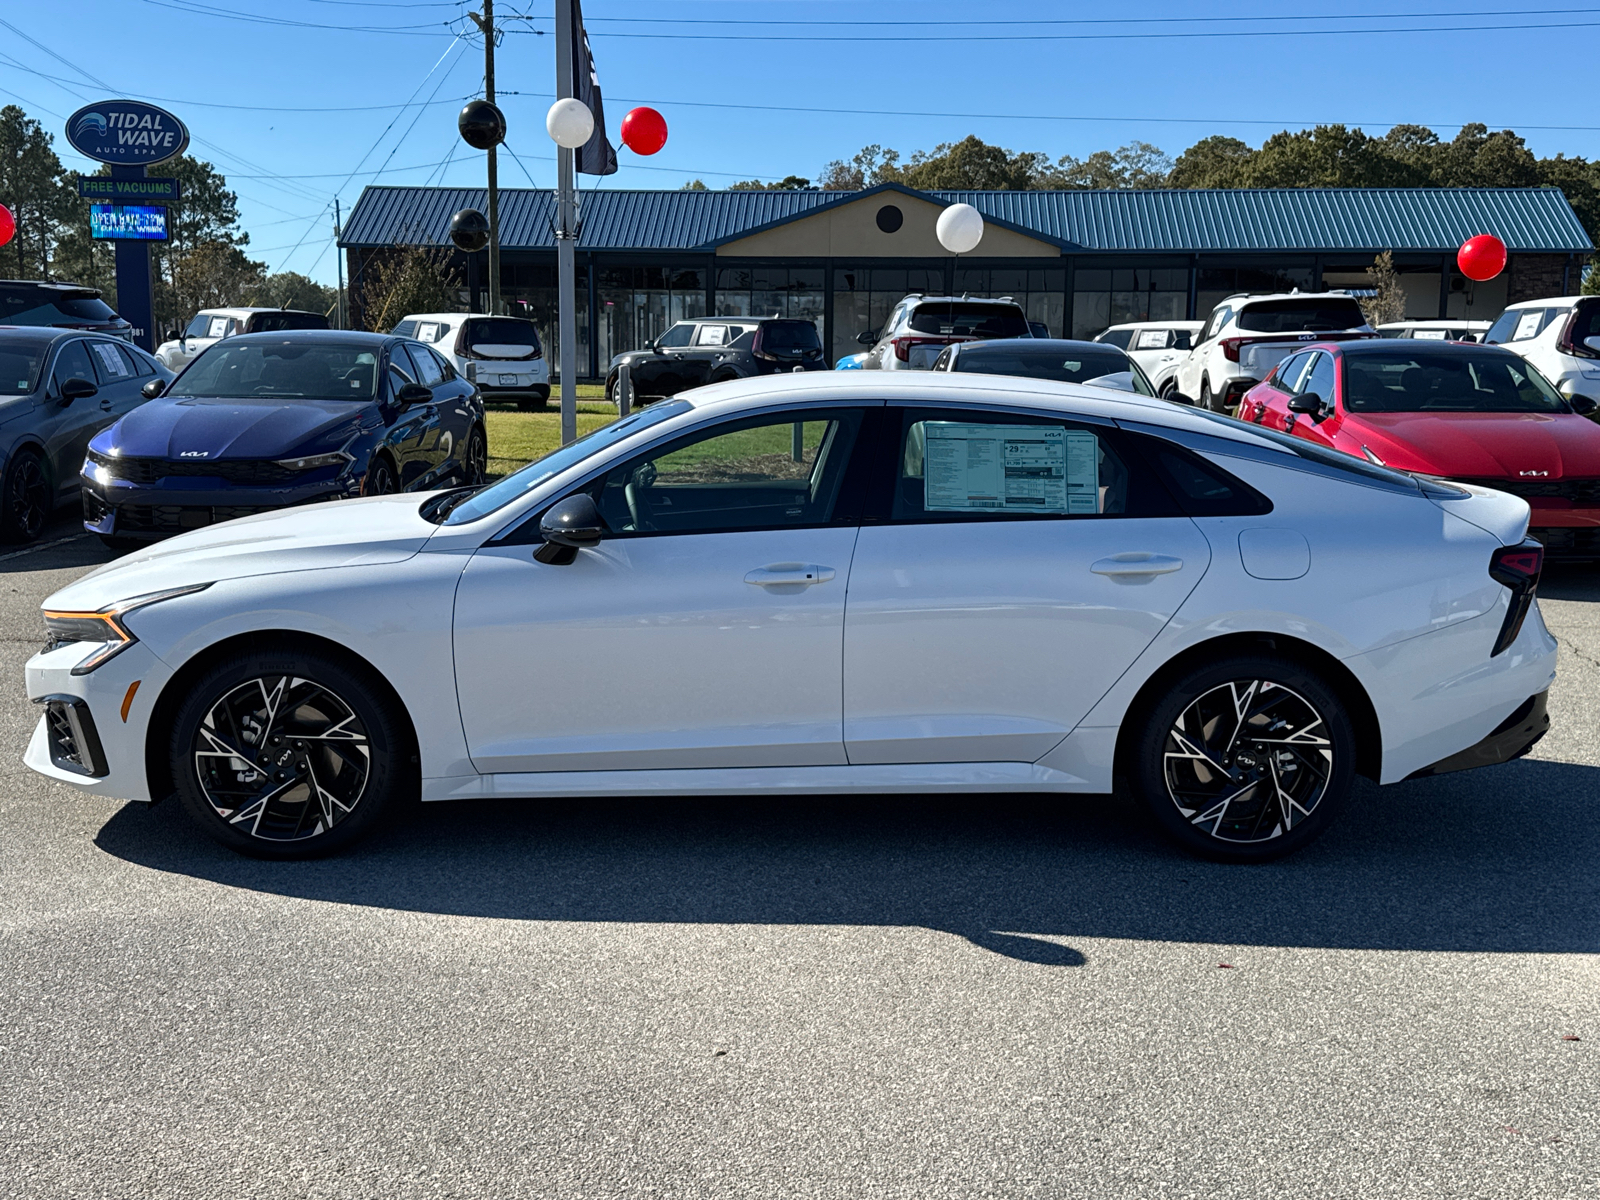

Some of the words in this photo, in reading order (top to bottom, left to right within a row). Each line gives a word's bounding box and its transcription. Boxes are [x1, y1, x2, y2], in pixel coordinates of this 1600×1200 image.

[108, 113, 163, 130] TIDAL
[118, 130, 174, 147] WAVE
[95, 146, 125, 154] AUTO
[83, 181, 114, 192] FREE
[117, 182, 172, 194] VACUUMS
[1009, 445, 1019, 453] 29
[259, 661, 296, 670] PIRELLI
